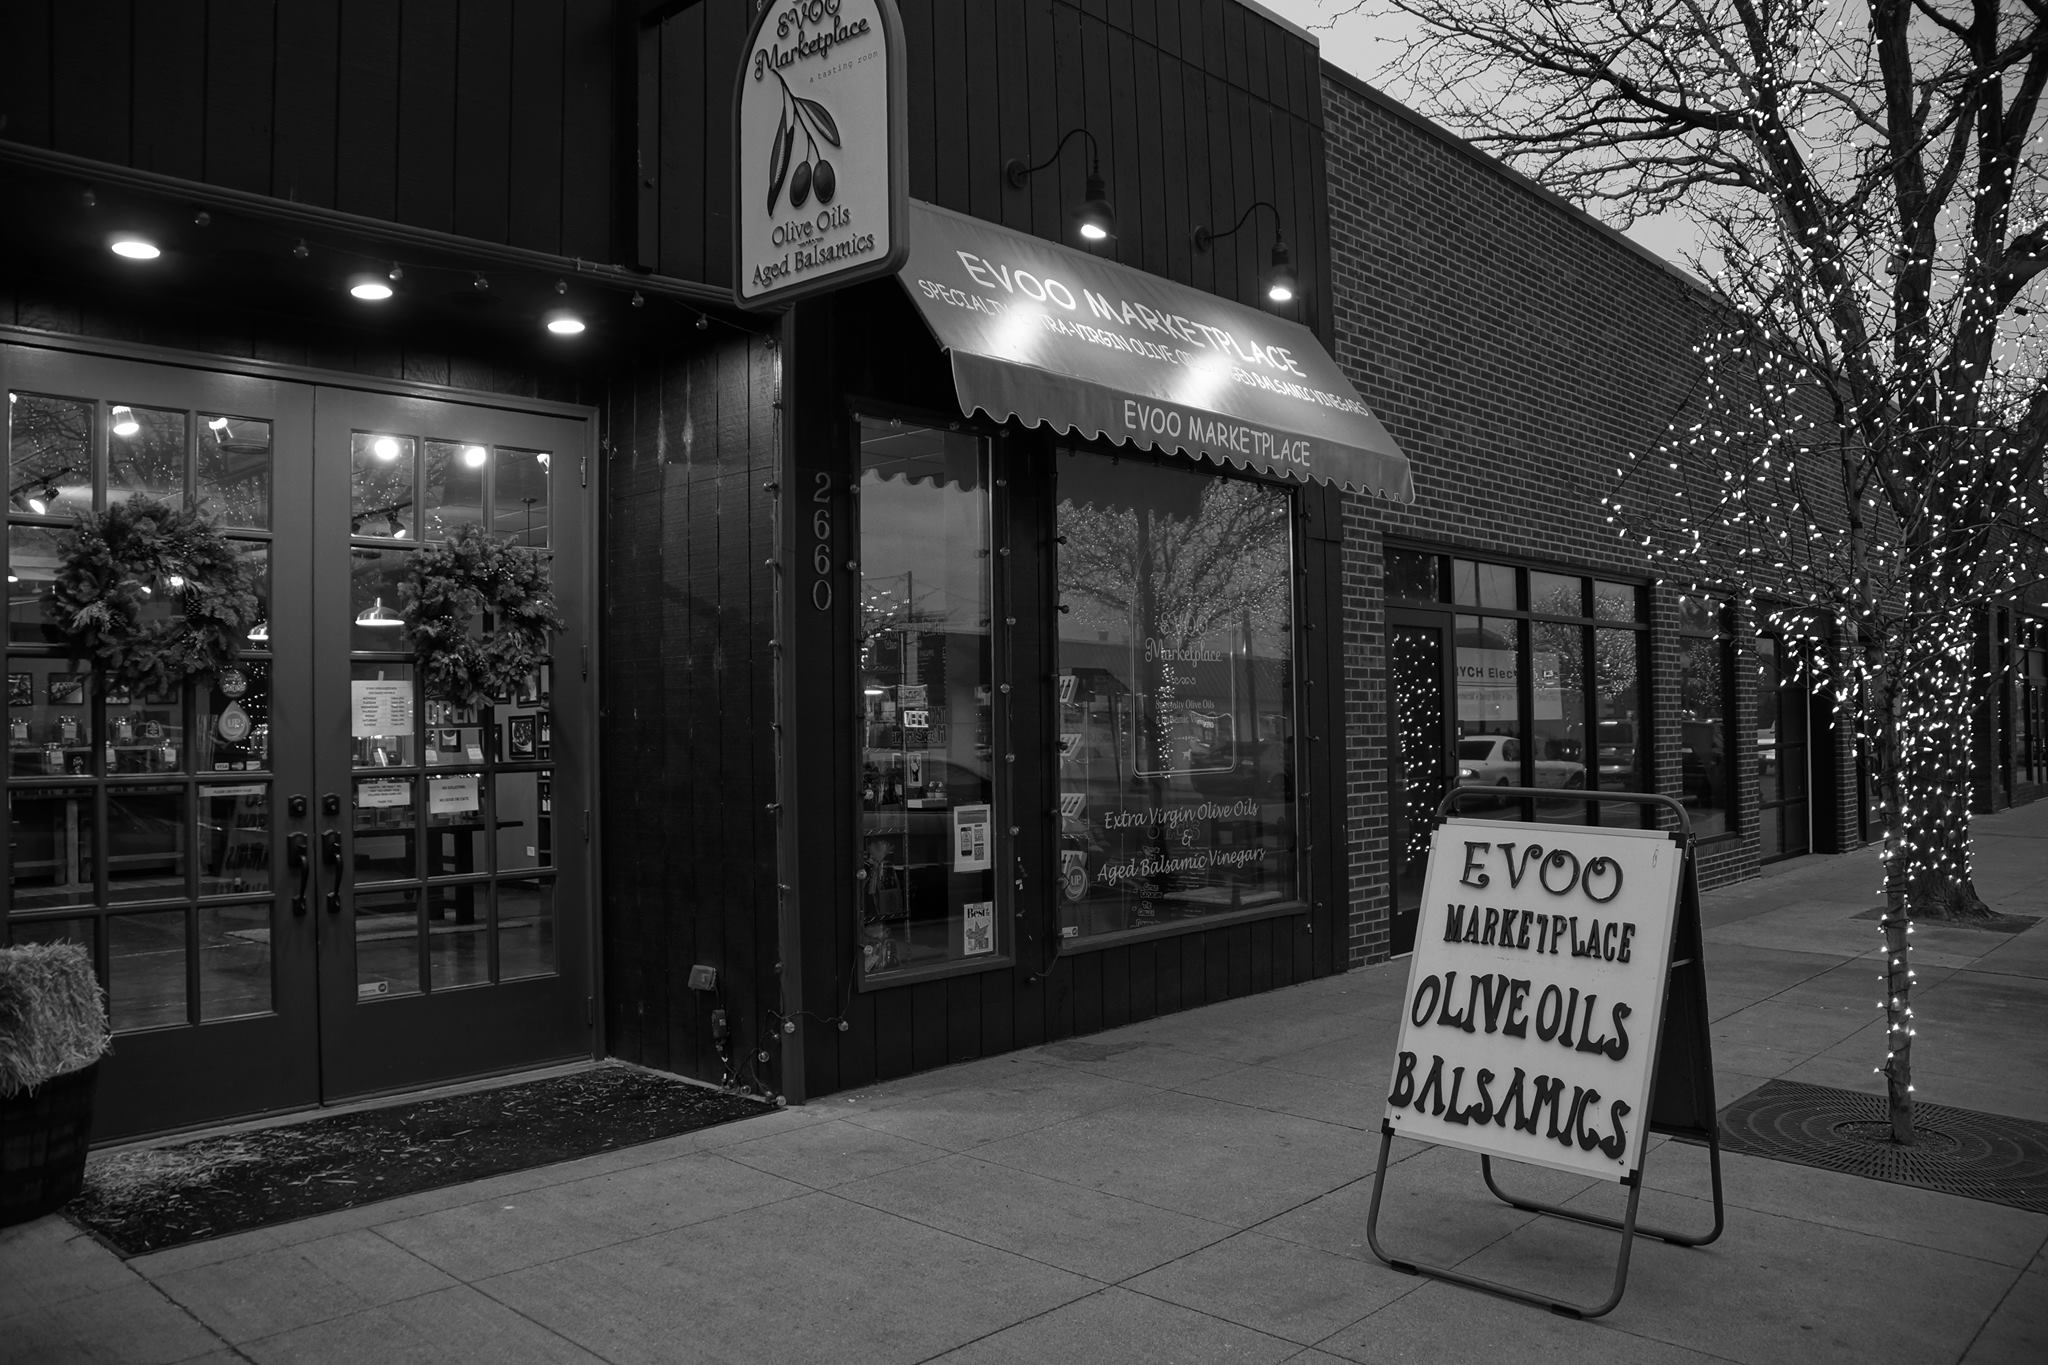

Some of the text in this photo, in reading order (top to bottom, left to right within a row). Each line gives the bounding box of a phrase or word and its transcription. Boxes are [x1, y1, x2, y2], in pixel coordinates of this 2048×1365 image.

[777, 0, 841, 38] EVOO
[754, 15, 870, 81] Marketplace
[817, 60, 853, 80] tasting
[857, 51, 879, 64] room
[772, 204, 850, 246] Olive Oils
[752, 232, 874, 287] Aged Balsamics
[956, 251, 1306, 377] EVOO MARKETPLACE
[1036, 313, 1132, 353] TRA-VIRGIN
[1130, 338, 1178, 364] OLIVE
[1230, 366, 1256, 387] GED
[1252, 371, 1315, 402] BALSAMIC
[1310, 388, 1369, 417] VINEGARS
[1124, 400, 1311, 467] EVOO MARKETPLACE
[813, 472, 832, 611] 2660
[1145, 637, 1223, 667] Marketplace
[1185, 698, 1202, 709] Olive
[1202, 698, 1215, 709] Oils
[1104, 809, 1147, 830] Extra
[1149, 805, 1196, 829] Virgin
[1197, 801, 1233, 820] Olive
[1234, 798, 1259, 817] Oils
[1181, 829, 1192, 847] &
[1097, 848, 1267, 886] Aged Balsamic Vinegars
[1459, 840, 1624, 903] EVOO
[967, 908, 985, 918] Best
[1443, 904, 1636, 963] MARKETPLACE
[1411, 971, 1632, 1061] OLIVE OILS
[1387, 1051, 1631, 1160] BALSAMICS
